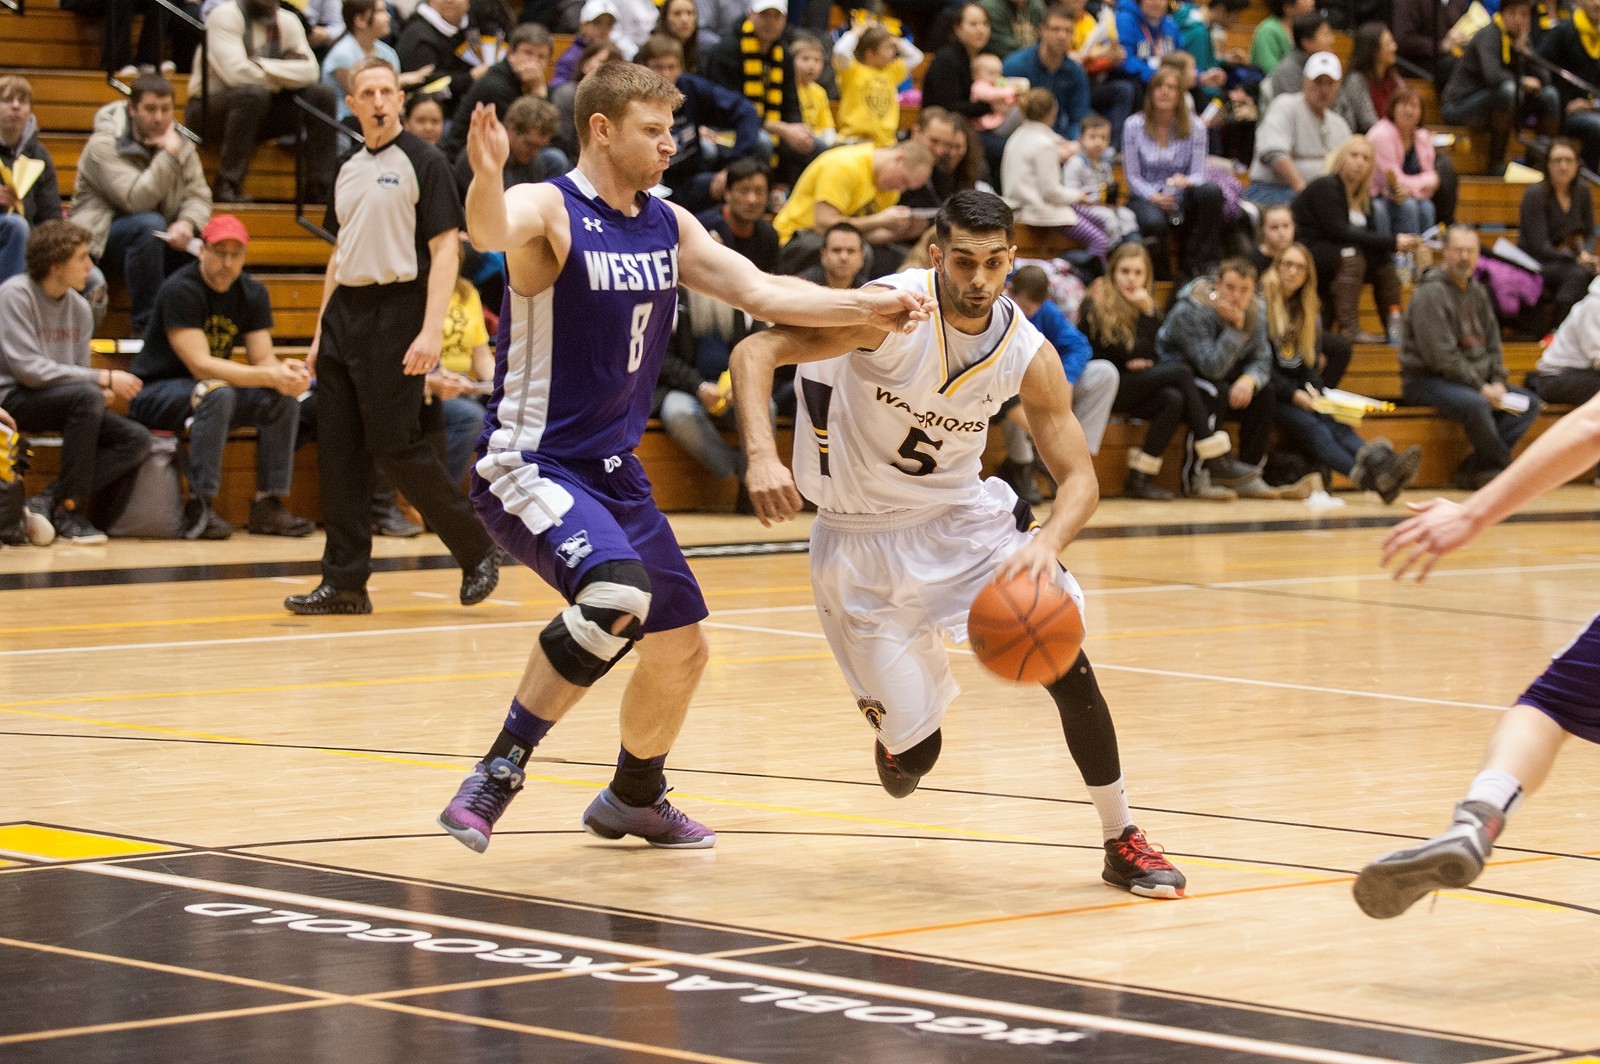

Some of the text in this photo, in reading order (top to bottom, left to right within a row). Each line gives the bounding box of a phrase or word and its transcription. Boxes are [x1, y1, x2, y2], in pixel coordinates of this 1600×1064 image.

[627, 302, 654, 374] 8
[875, 386, 986, 433] WARRIORS
[888, 426, 943, 477] 5
[183, 902, 1086, 1046] #GOBLACKGOGOLD
